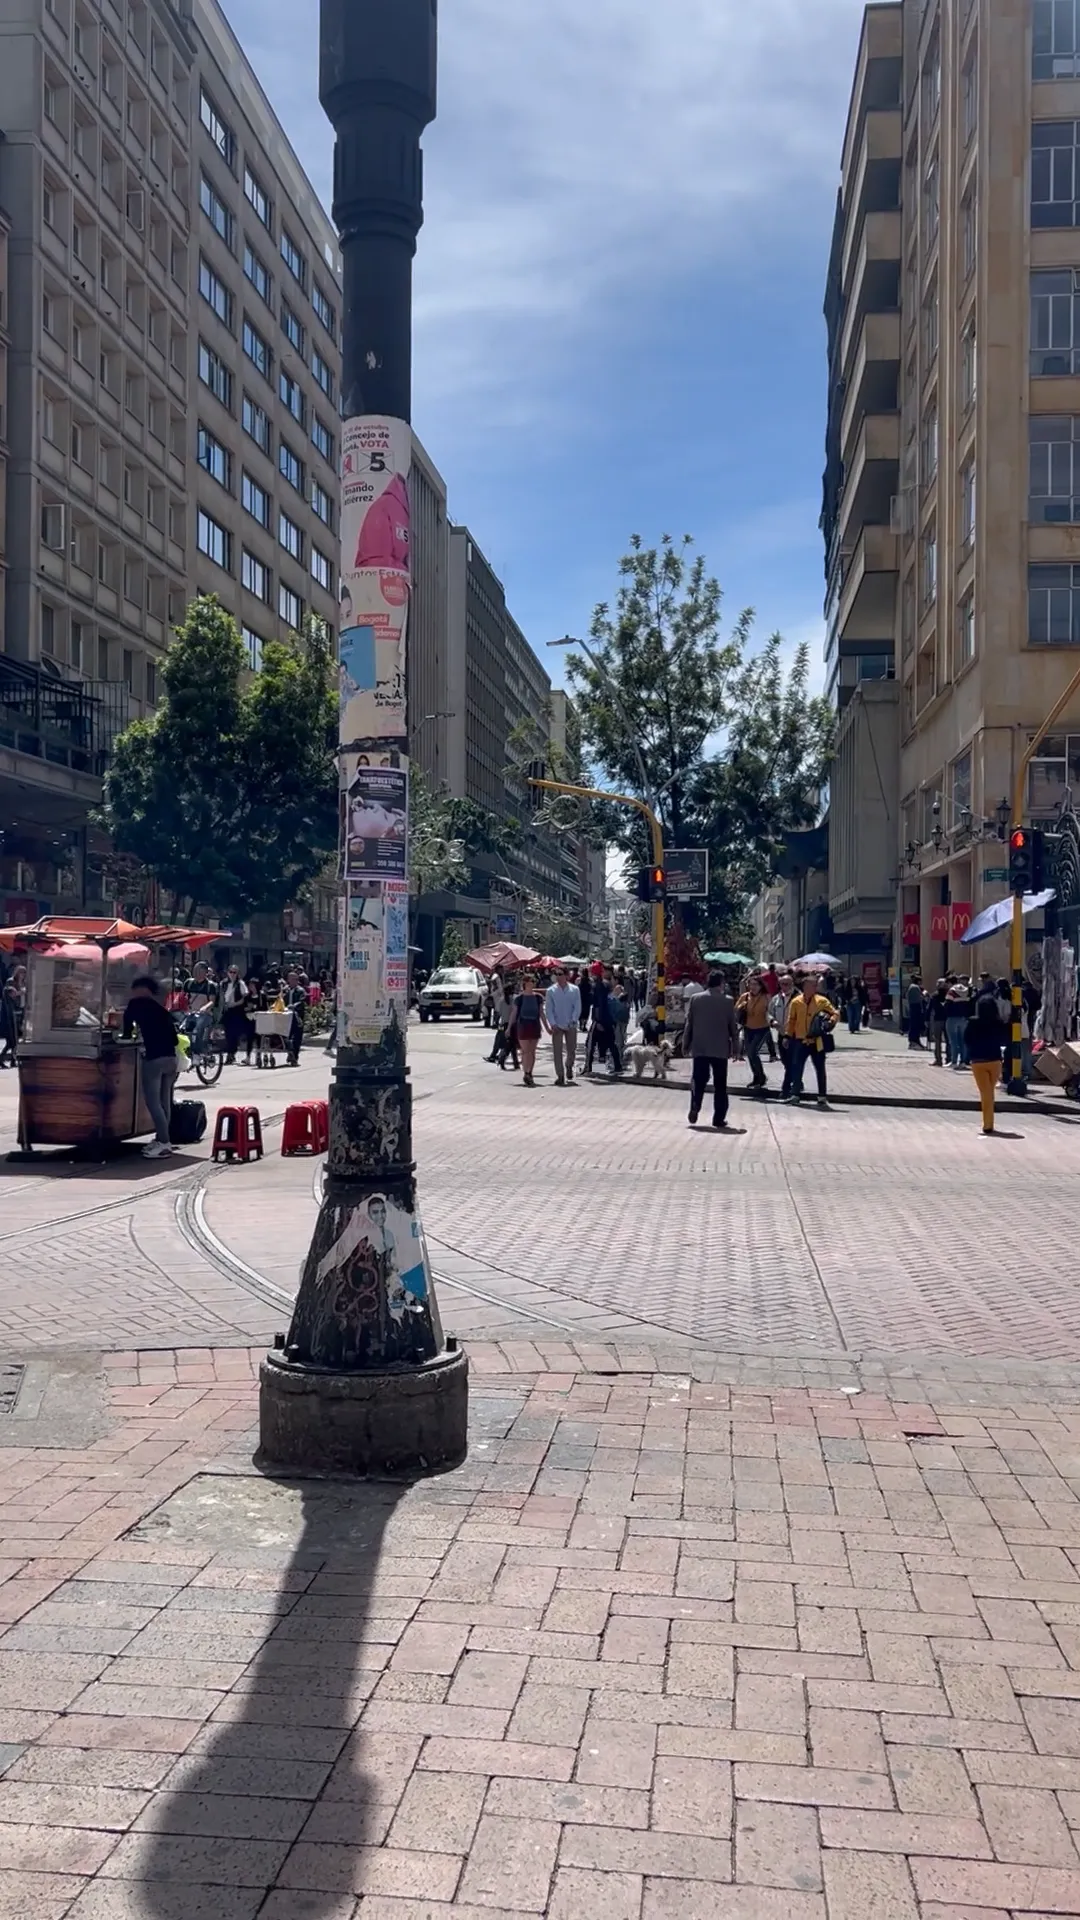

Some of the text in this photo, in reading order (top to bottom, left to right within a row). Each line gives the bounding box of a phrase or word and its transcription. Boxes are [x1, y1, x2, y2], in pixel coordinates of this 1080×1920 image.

[360, 440, 389, 449] VOTA
[369, 452, 386, 472] 5
[359, 614, 388, 624] Bogotá
